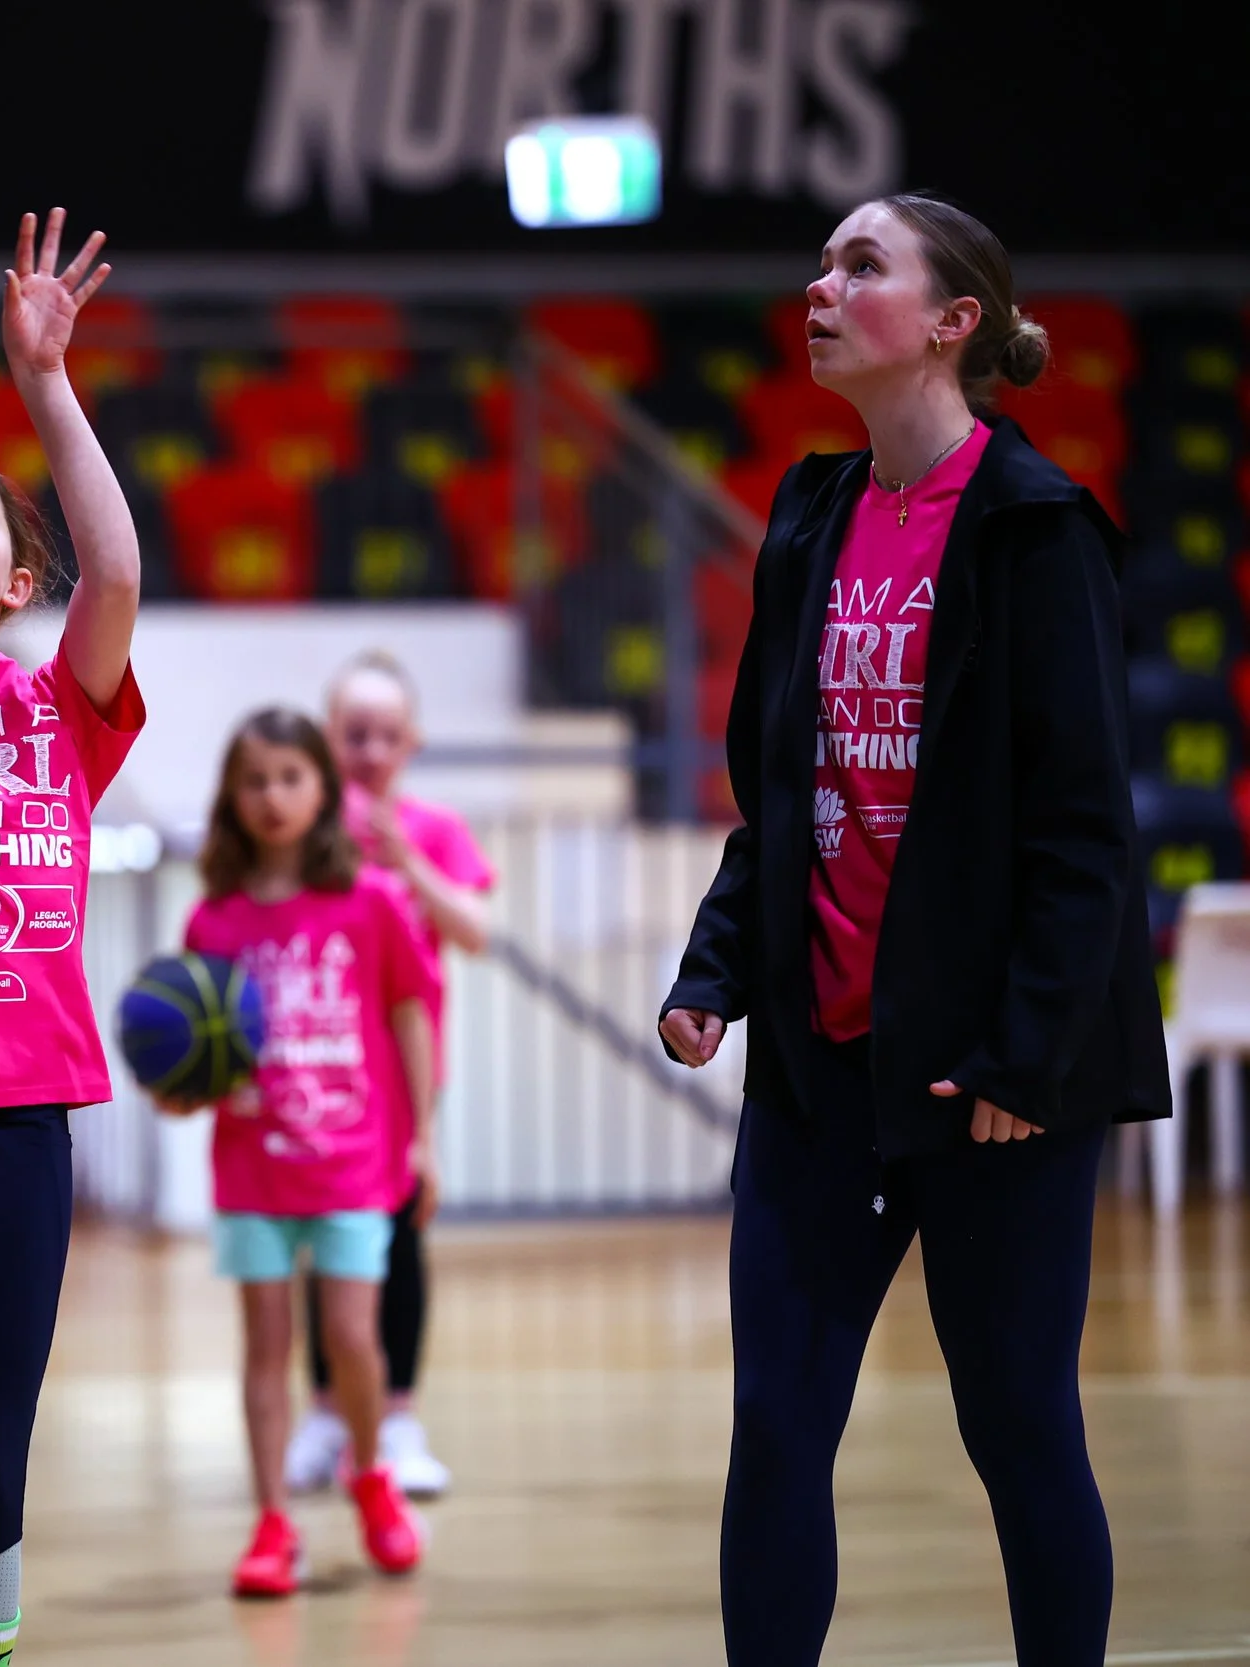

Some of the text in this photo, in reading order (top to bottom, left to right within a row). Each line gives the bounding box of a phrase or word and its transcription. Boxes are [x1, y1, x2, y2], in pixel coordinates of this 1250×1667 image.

[248, 0, 912, 222] NORTHS
[818, 620, 925, 692] IRL
[21, 801, 69, 830] DO
[814, 827, 845, 850] SW
[28, 920, 72, 929] PROGRAM
[34, 911, 67, 920] LEGACY
